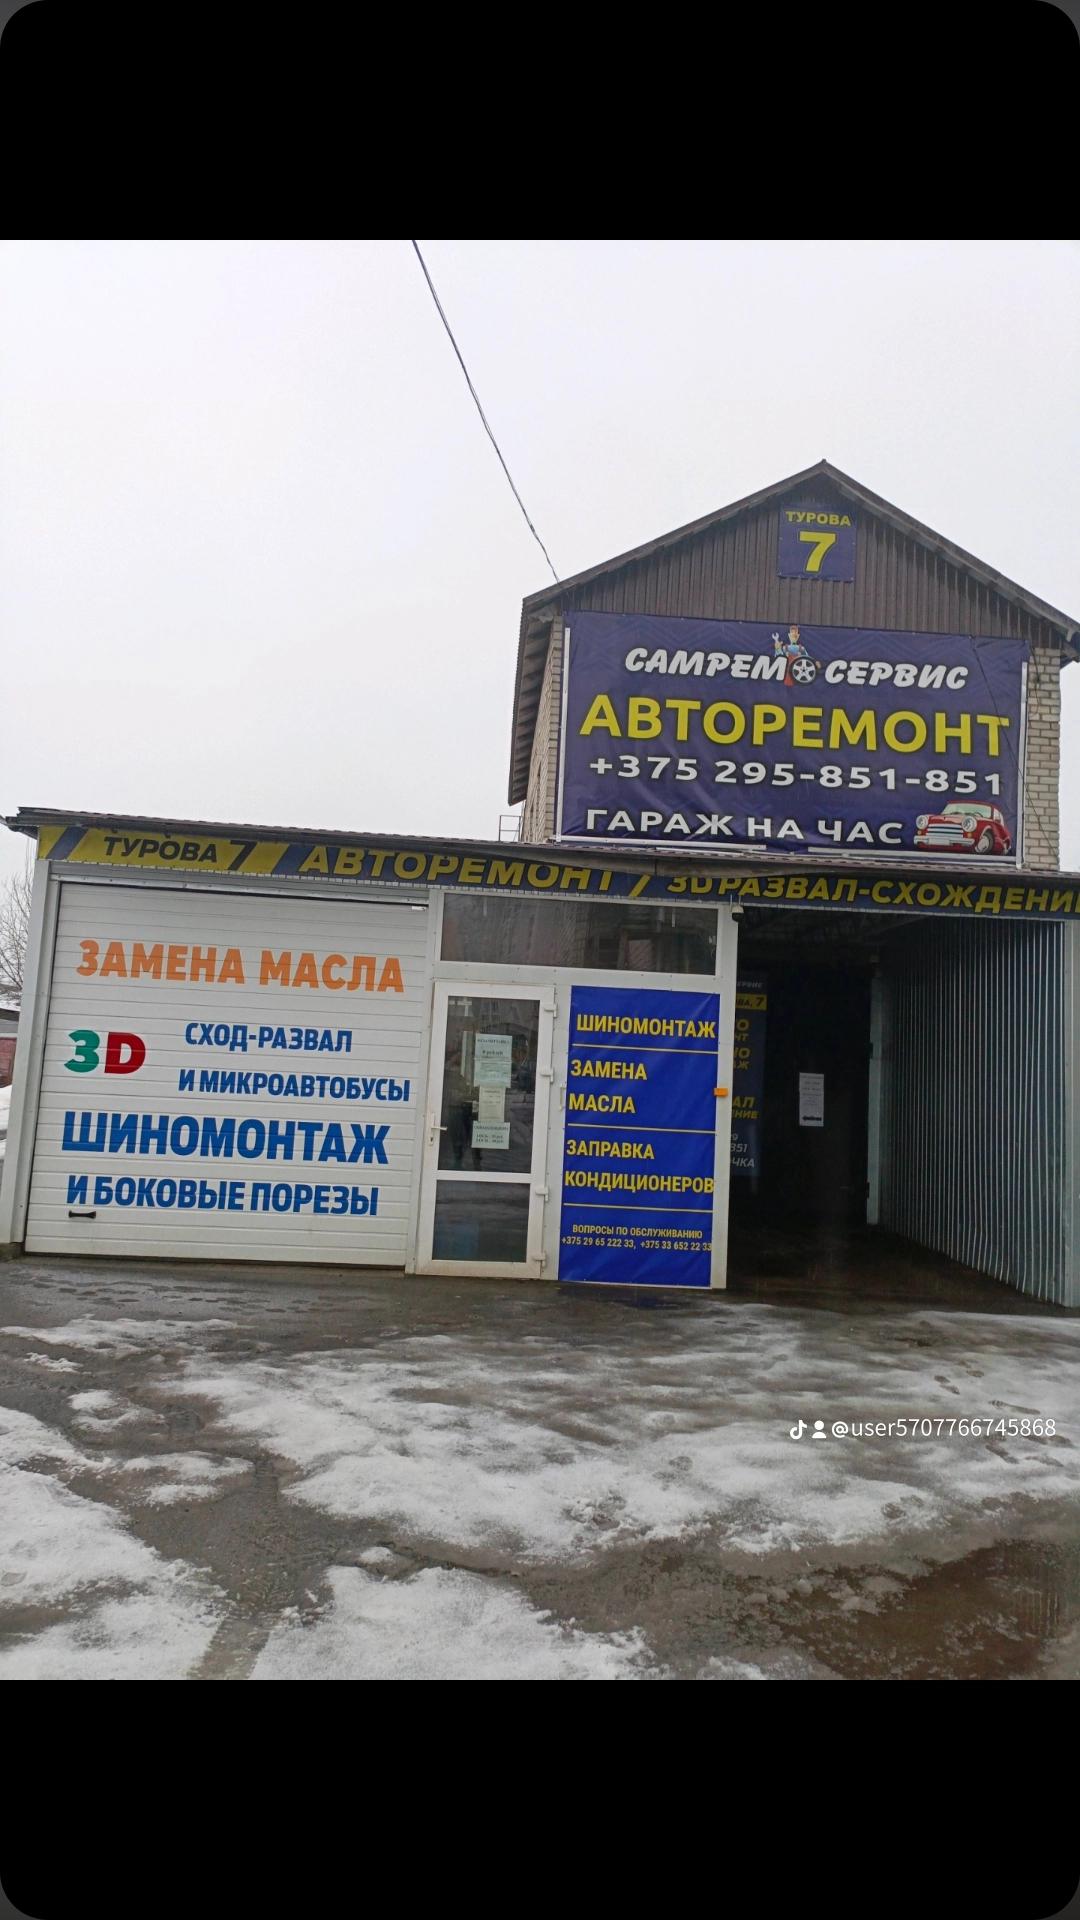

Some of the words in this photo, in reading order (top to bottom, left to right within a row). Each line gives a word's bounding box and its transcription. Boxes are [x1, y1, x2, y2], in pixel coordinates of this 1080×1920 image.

[785, 510, 852, 528] ТУРОВА
[799, 531, 837, 572] 7
[625, 648, 788, 682] САМРЕМ
[824, 660, 969, 690] СЕРВИС
[579, 694, 1010, 757] АВТОРЕМОНТ
[590, 756, 699, 781] +375
[714, 760, 1002, 796] 295-851-851
[586, 809, 734, 837] ГАРАЖ
[747, 816, 805, 840] НА
[817, 820, 904, 845] ЧАС
[103, 836, 219, 863] ТУРОВА
[226, 839, 260, 871] 7
[299, 845, 615, 892] АВТОРЕМОНТ
[717, 876, 1080, 914] РАЗВАЛ-СХОЖДЕНИ
[76, 940, 246, 985] ЗАМЕНА
[259, 950, 405, 993] МАСЛА
[185, 1022, 353, 1053] СХОД-РАЗВАЛ
[576, 1014, 717, 1039] ШИНОМОНТАЖ
[64, 1029, 146, 1075] 3D
[178, 1069, 196, 1093] И
[198, 1070, 411, 1102] МИКРОАВТОБУСЫ
[570, 1059, 648, 1081] ЗАМЕНА
[568, 1093, 636, 1114] МАСЛА
[61, 1111, 391, 1165] ШИНОМОНТАЖ
[566, 1139, 656, 1160] ЗАПРАВКА
[66, 1175, 89, 1205] И
[94, 1176, 244, 1211] БОКОВЫЕ
[250, 1182, 379, 1216] ПОРЕЗЫ
[564, 1170, 715, 1195] КОНДИЦИОНЕРОВ
[561, 1236, 581, 1245] +375
[583, 1237, 593, 1245] 29
[595, 1237, 605, 1246] 65
[607, 1238, 622, 1247] 222
[640, 1240, 660, 1248] +375
[662, 1240, 672, 1249] 33
[674, 1240, 689, 1250] 652
[690, 1241, 701, 1251] 22
[702, 1242, 713, 1251] 33
[572, 1224, 614, 1235] ВОПРОСЫ
[616, 1226, 628, 1236] ПО
[630, 1226, 703, 1239] ОБСЛУЖИВАНИЮ
